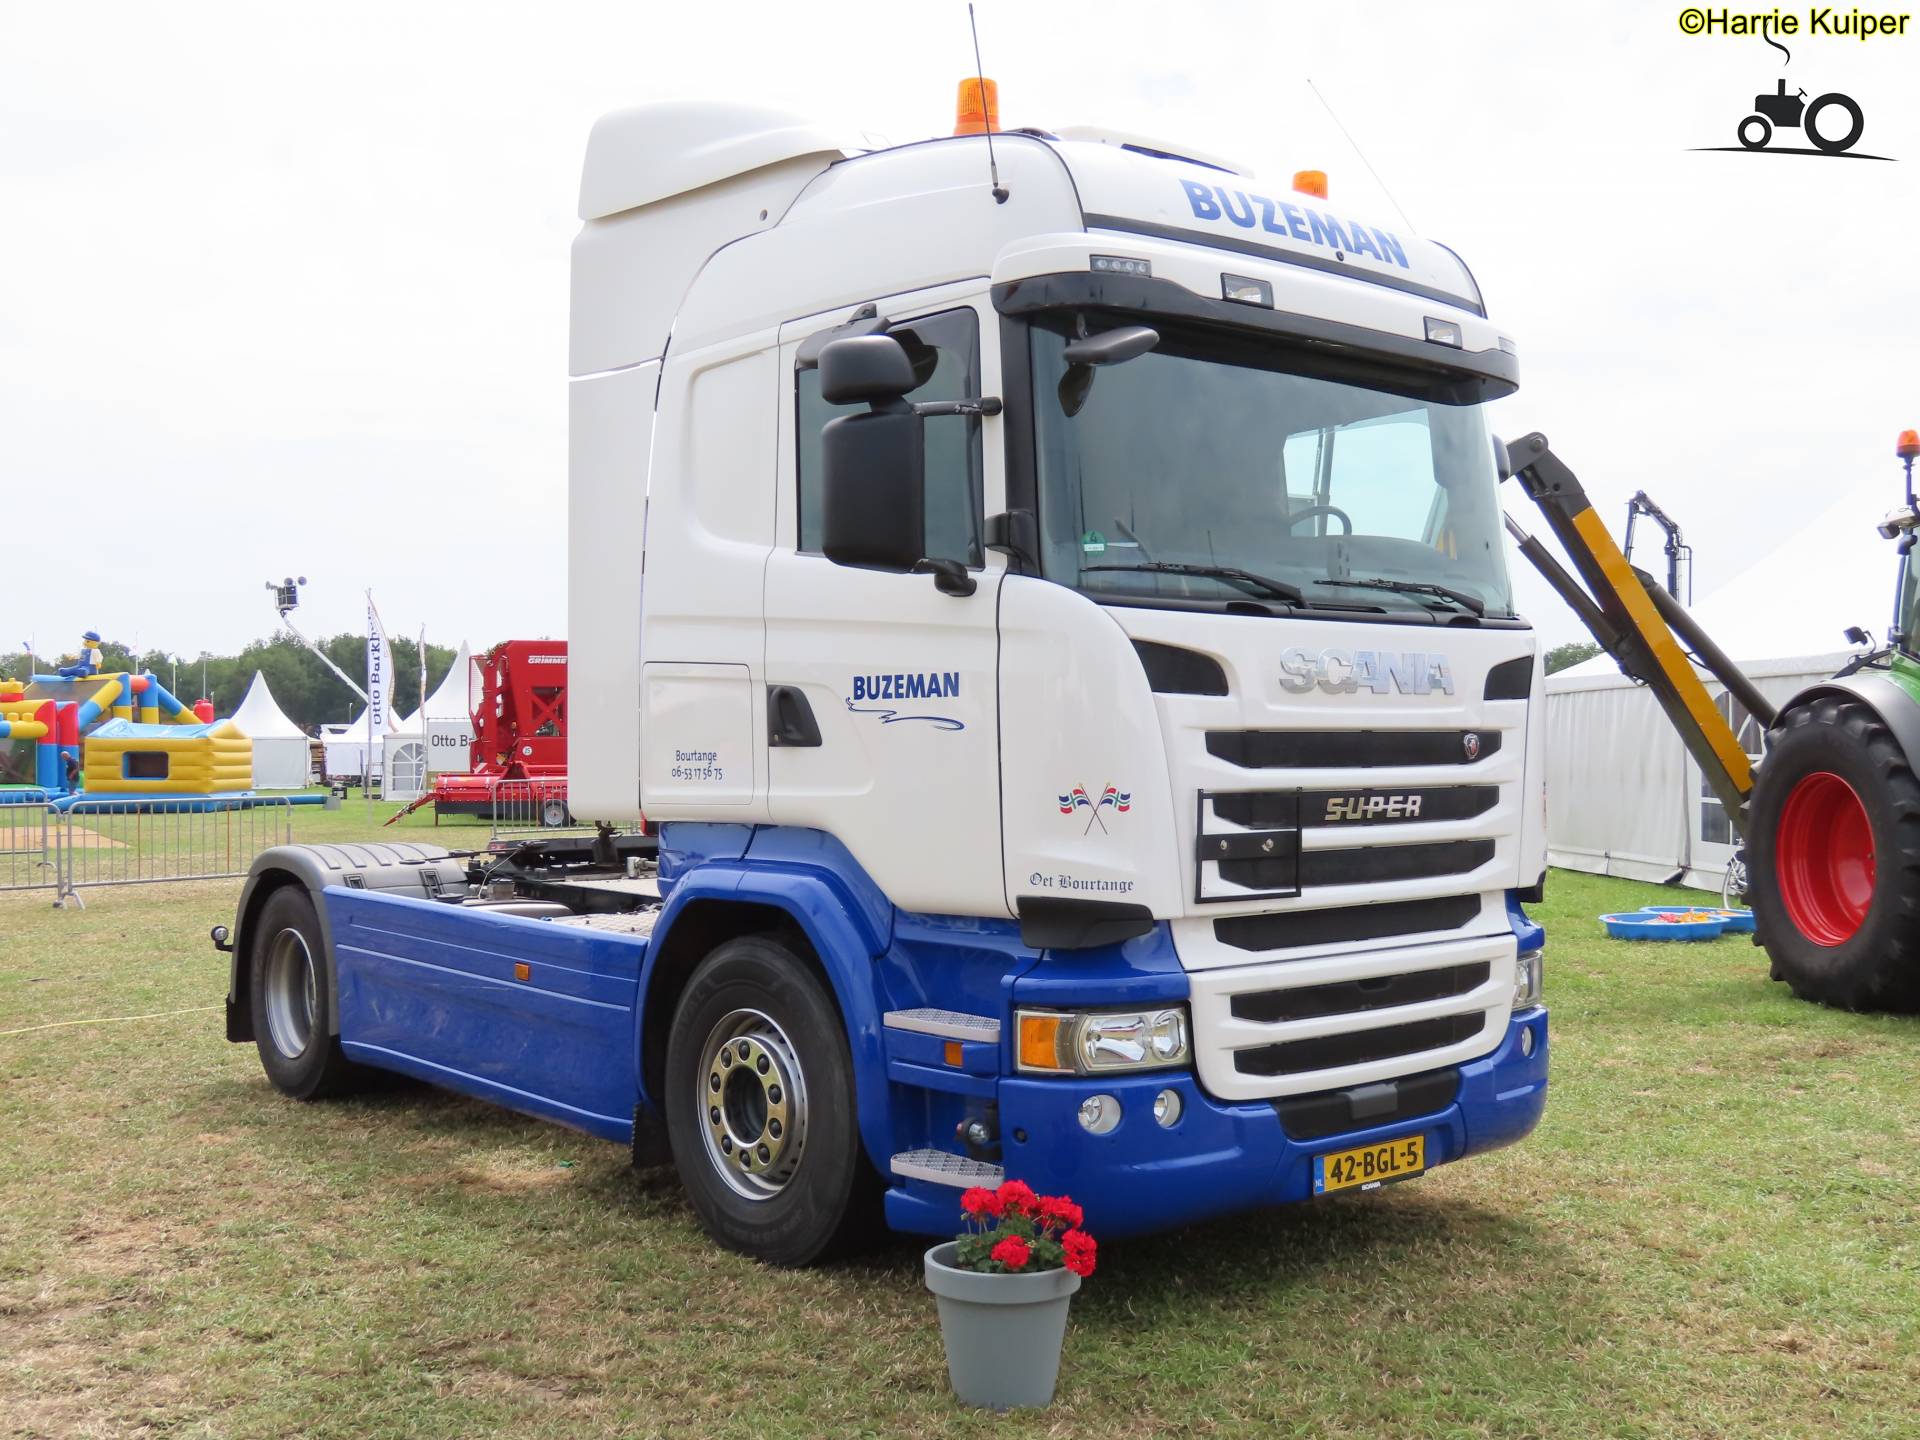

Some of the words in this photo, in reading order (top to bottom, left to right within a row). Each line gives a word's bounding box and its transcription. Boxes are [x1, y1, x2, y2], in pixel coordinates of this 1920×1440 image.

[1179, 179, 1410, 268] BUZEMAN
[1279, 647, 1455, 695] SCANIA
[853, 672, 960, 701] BUZEMAN
[431, 734, 457, 747] Otto
[675, 749, 718, 765] Bourtange
[671, 765, 693, 780] 06-53
[694, 768, 702, 780] 17
[703, 765, 713, 780] 56
[714, 768, 723, 780] 75
[1324, 795, 1422, 821] SUPER
[1058, 874, 1135, 893] Bourtange
[1315, 1178, 1324, 1187] NL
[1330, 1141, 1418, 1183] 42-BGL-5
